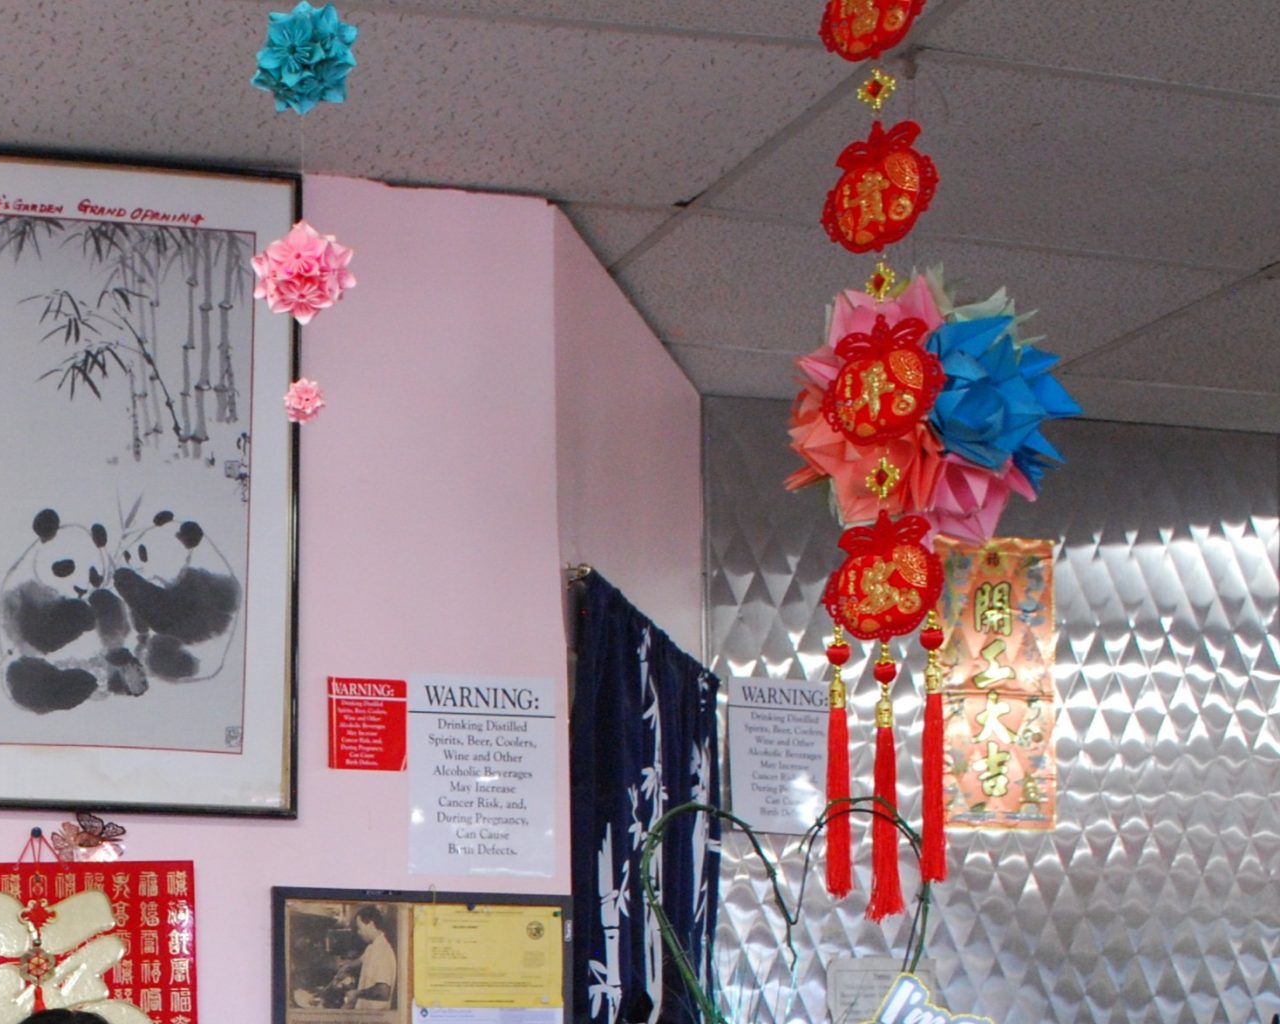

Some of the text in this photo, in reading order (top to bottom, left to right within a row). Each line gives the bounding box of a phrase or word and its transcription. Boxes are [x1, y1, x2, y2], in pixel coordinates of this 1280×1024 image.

[77, 199, 126, 218] GRAND
[331, 682, 394, 696] WARNING:
[973, 581, 1018, 797] 開工大吉
[425, 685, 540, 710] WARNING:
[741, 686, 829, 707] WARNING:
[438, 719, 528, 732] Drinking Distilled
[428, 734, 537, 749] Spirits, Beer, Coolers,
[443, 750, 523, 763] Wine and Other
[433, 766, 533, 780] Alcoholic Beverages
[450, 782, 516, 794] May Increase
[438, 796, 527, 810] Cancer Risk, and,
[437, 812, 529, 827] During Pregnancy,
[456, 829, 510, 840] Can Cause
[477, 844, 518, 856] Defects.
